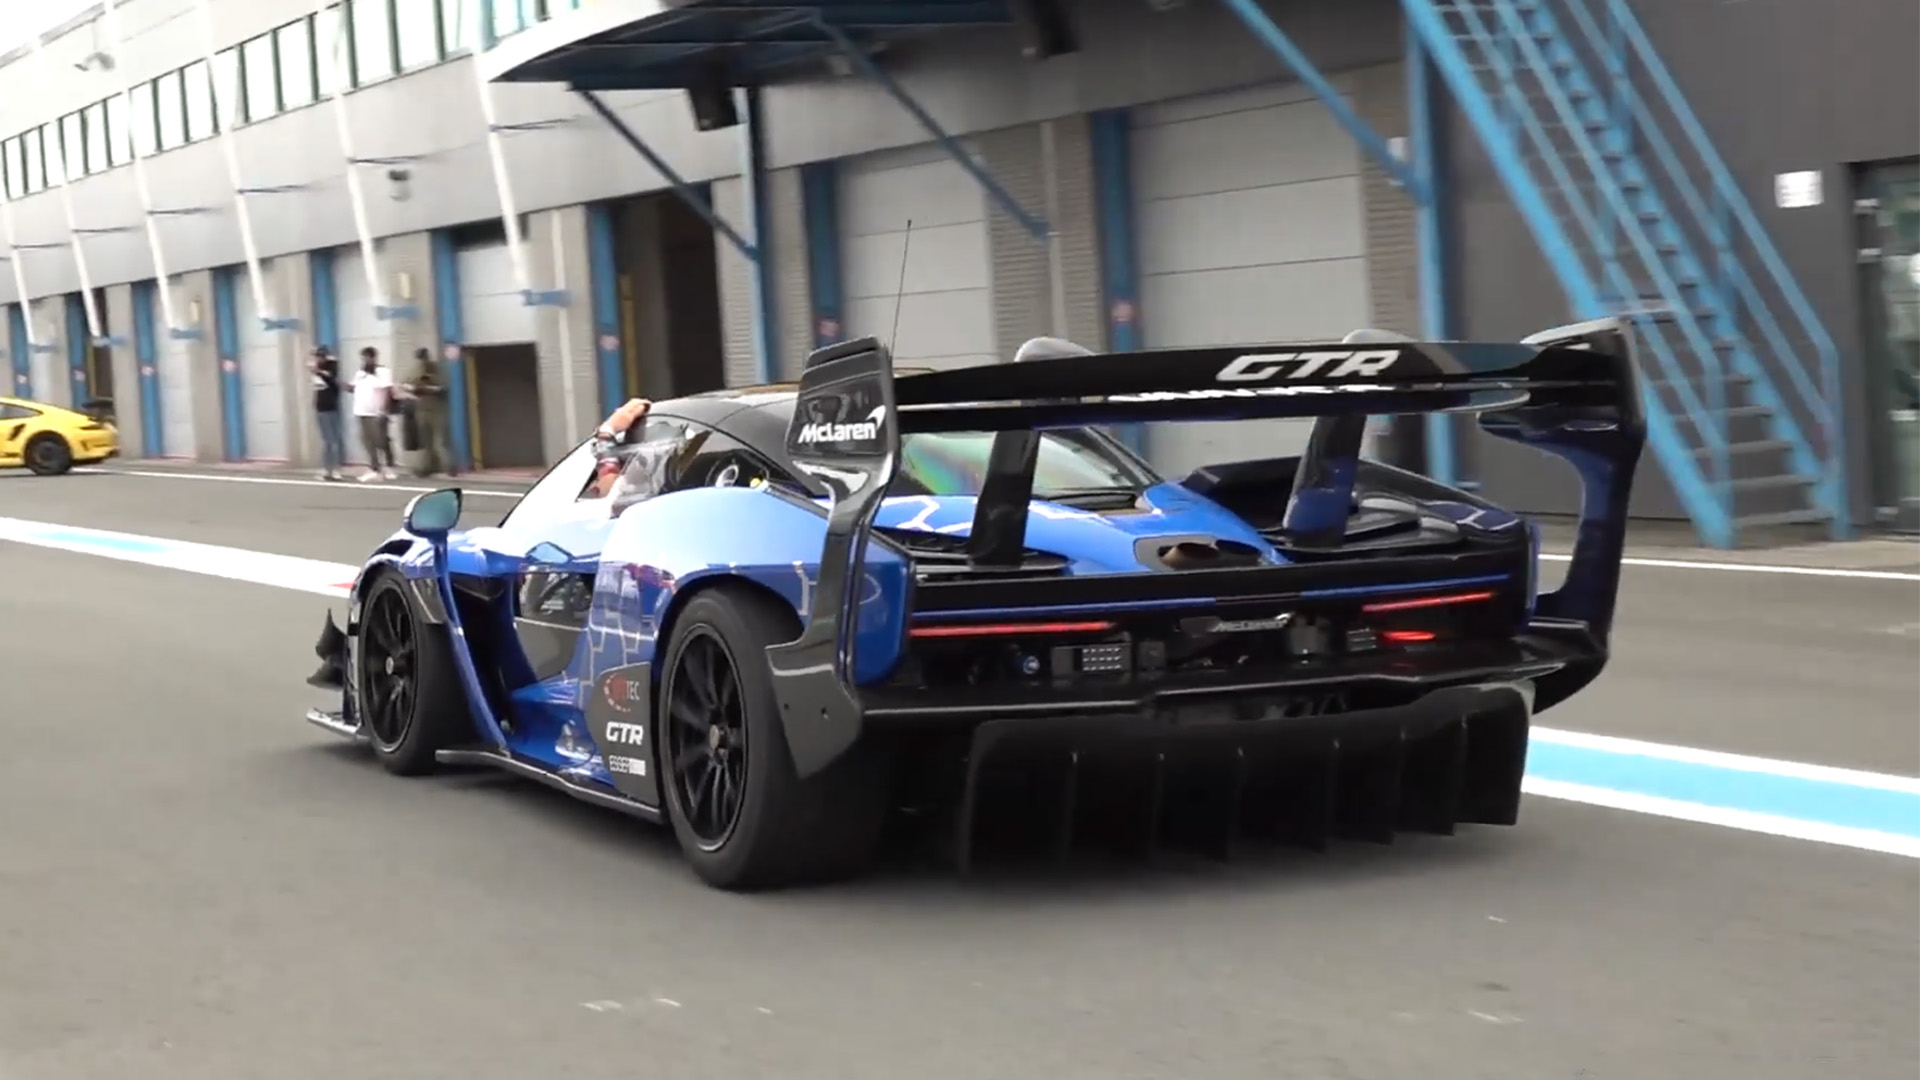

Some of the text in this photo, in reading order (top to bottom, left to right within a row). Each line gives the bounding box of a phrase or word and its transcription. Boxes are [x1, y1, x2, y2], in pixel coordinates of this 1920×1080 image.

[1216, 350, 1399, 380] GTR
[797, 421, 877, 444] McLaren
[606, 721, 643, 745] GTR
